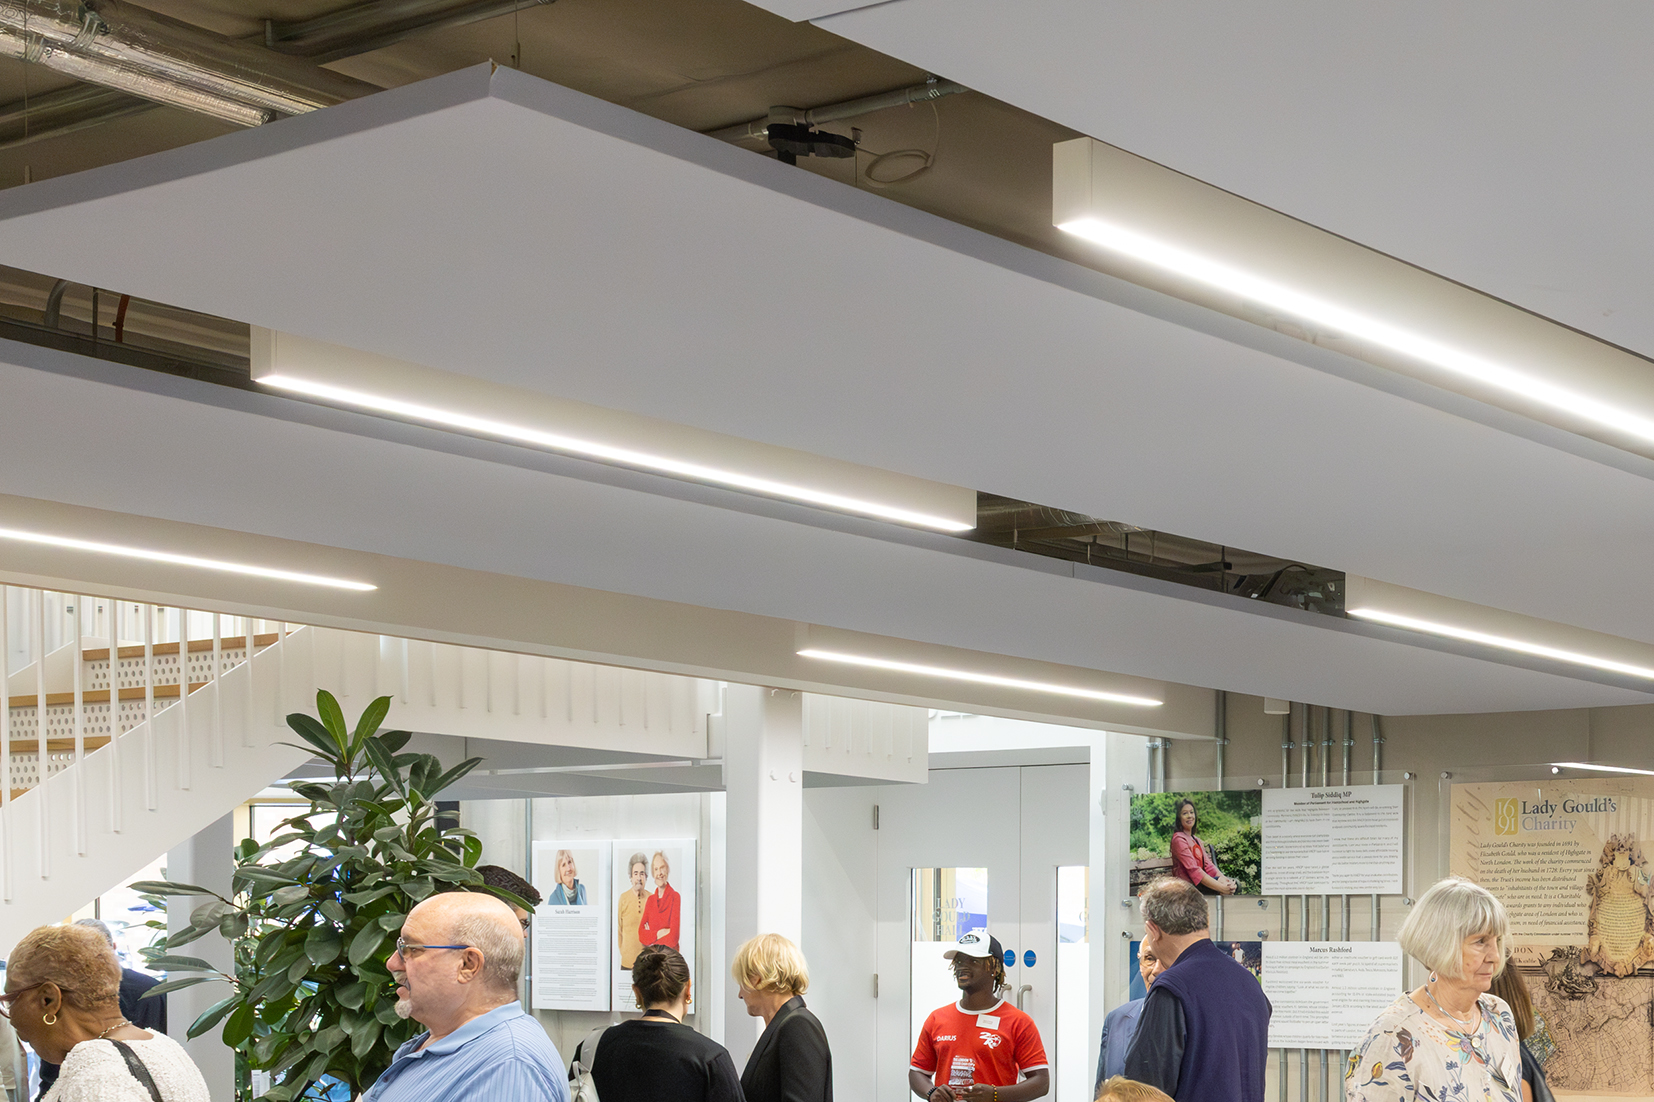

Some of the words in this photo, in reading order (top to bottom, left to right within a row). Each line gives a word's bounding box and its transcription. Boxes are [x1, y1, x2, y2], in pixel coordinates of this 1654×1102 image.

[1522, 801, 1557, 818] Lady
[1563, 798, 1617, 813] Gould's
[1522, 817, 1576, 833] Charity
[936, 898, 965, 908] LADY
